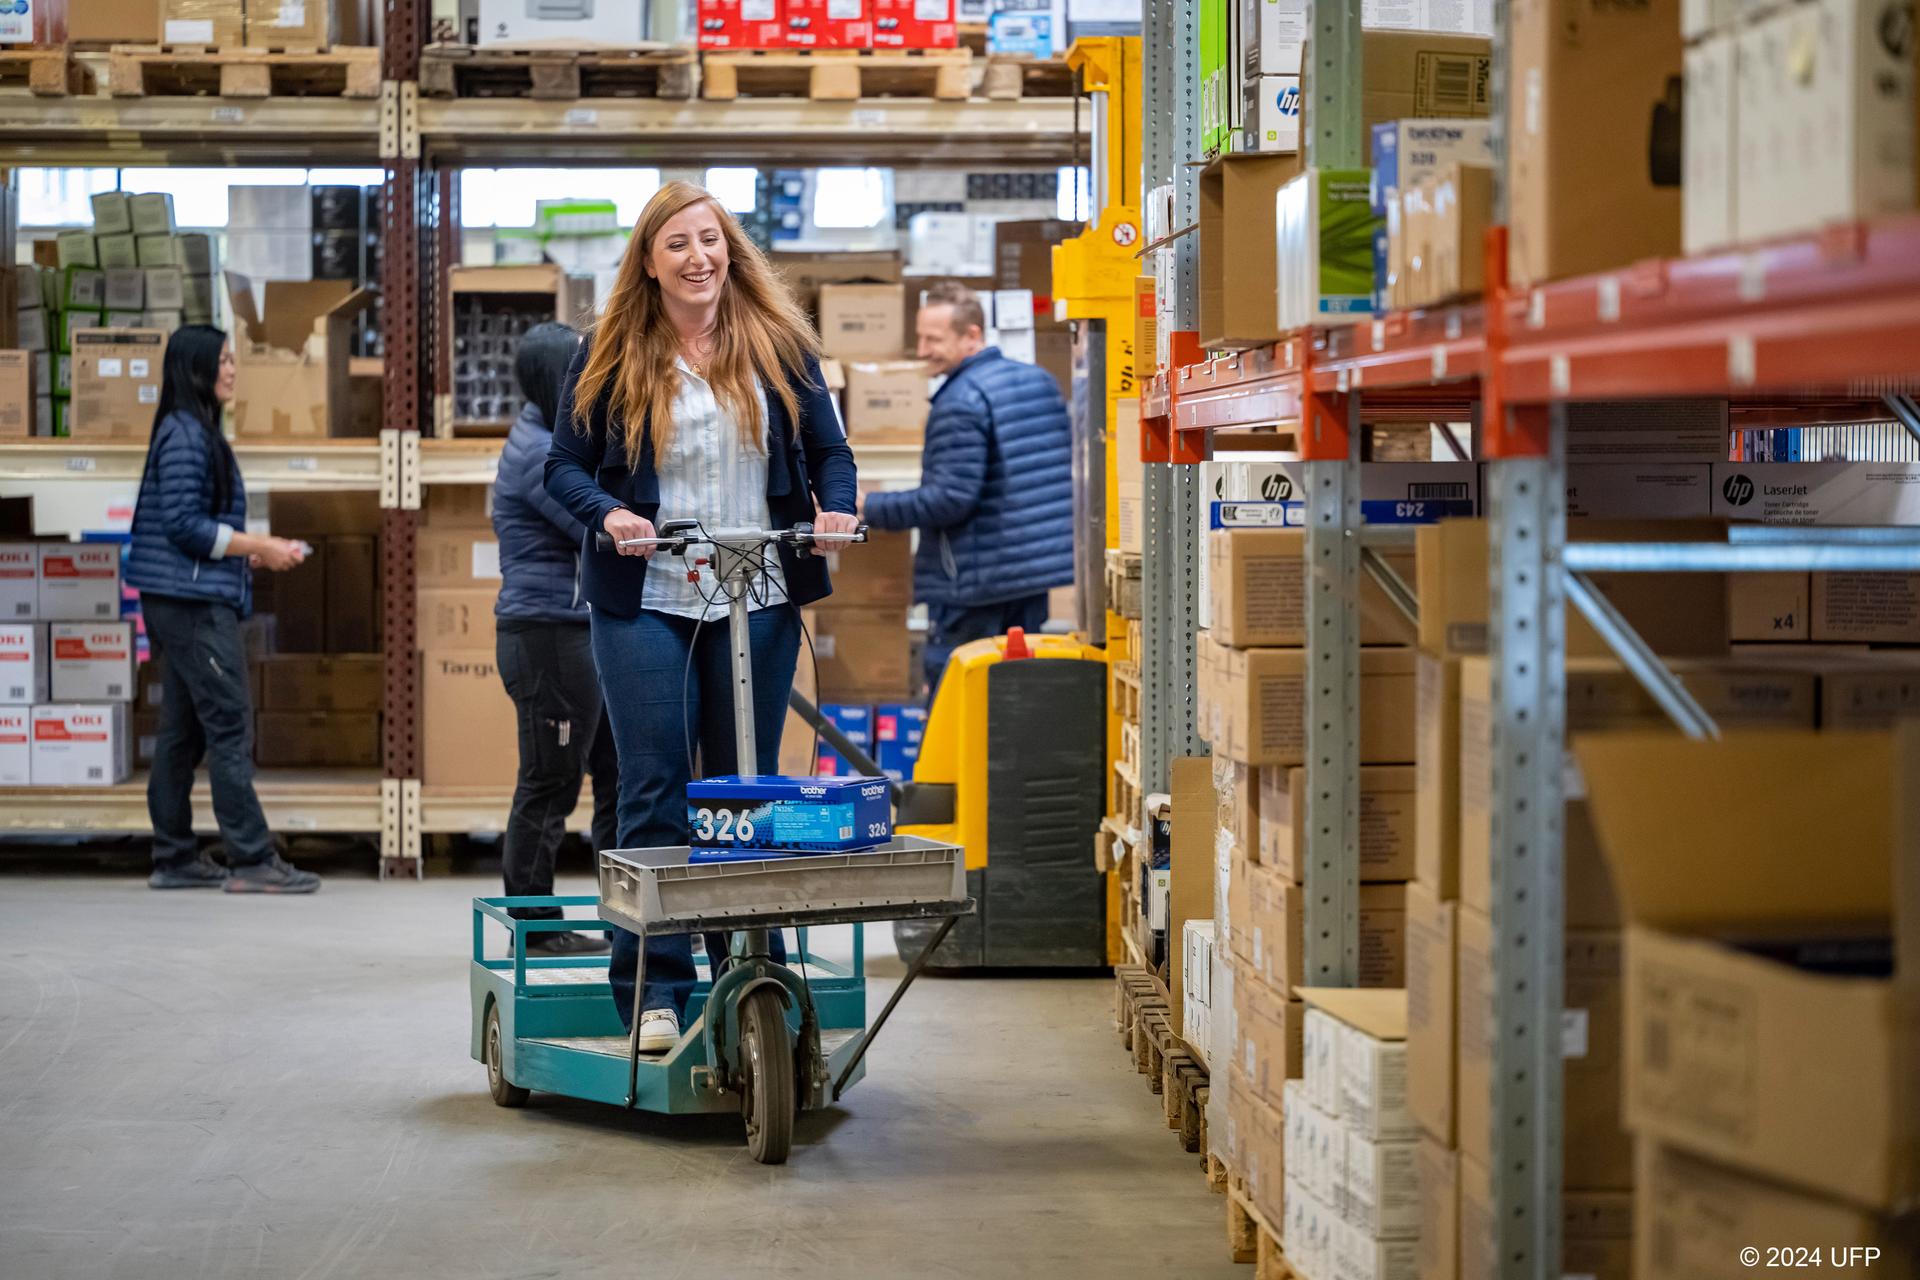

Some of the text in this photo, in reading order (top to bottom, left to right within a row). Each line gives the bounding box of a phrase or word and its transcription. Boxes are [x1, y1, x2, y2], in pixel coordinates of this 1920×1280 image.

[1476, 71, 1490, 103] Trust
[1277, 87, 1299, 116] hp
[1262, 474, 1293, 500] hp
[1723, 474, 1754, 506] hp
[1763, 484, 1808, 496] LaserJet
[1396, 502, 1424, 517] 243
[80, 552, 110, 563] OKI
[1774, 613, 1794, 630] x4
[92, 634, 121, 645] OKI
[72, 714, 103, 726] OKI
[800, 785, 827, 795] brother
[861, 784, 886, 796] brother
[696, 808, 755, 842] 326
[868, 821, 887, 838] 326
